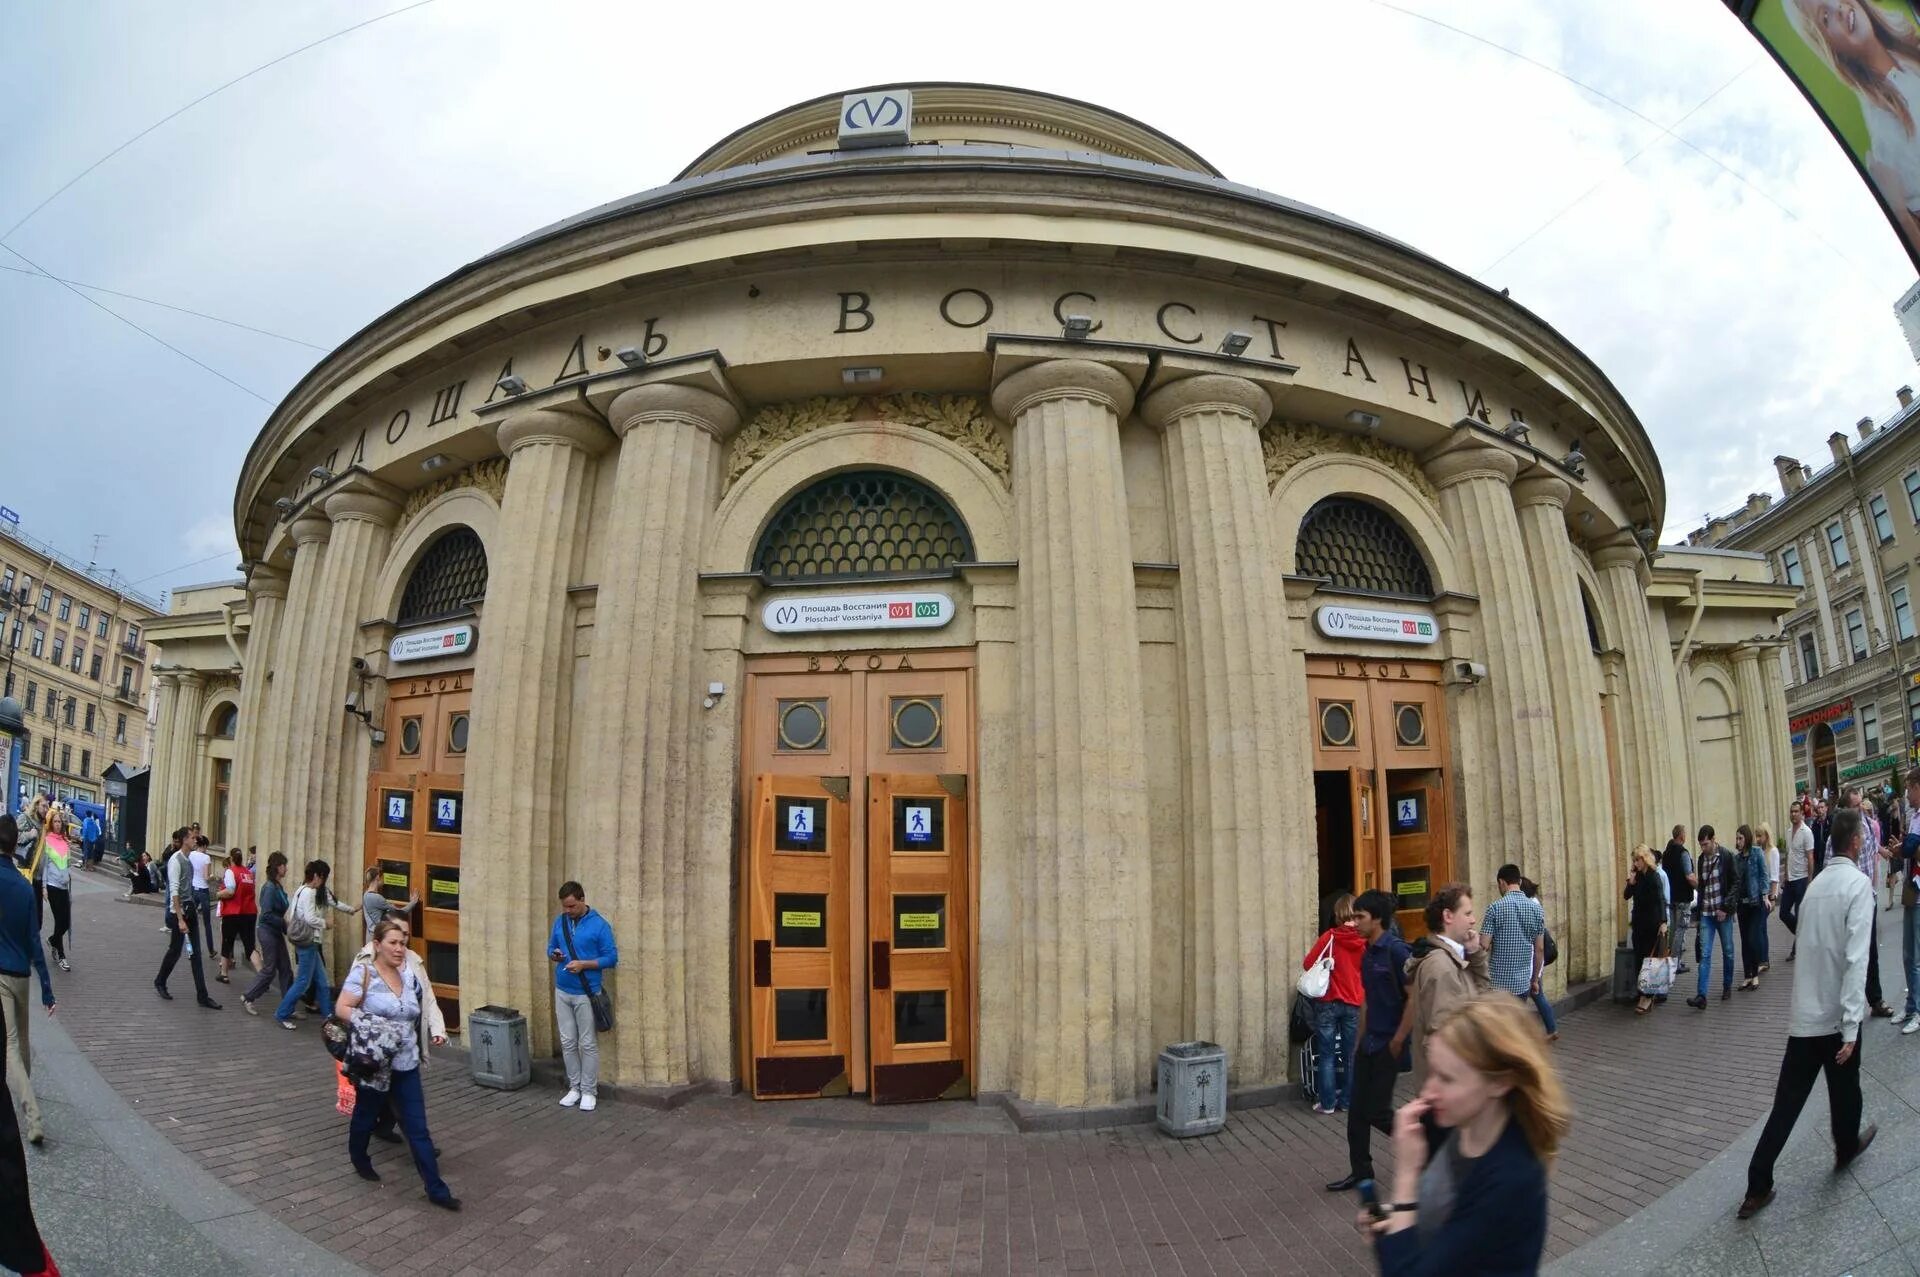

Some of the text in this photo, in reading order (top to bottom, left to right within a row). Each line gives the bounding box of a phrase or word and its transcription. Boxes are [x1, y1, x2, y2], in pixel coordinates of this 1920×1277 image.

[801, 602, 888, 613] Площадь Восстания
[808, 652, 913, 672] ВХОД
[1336, 661, 1410, 678] ВХОД
[409, 674, 463, 695] ВХОД
